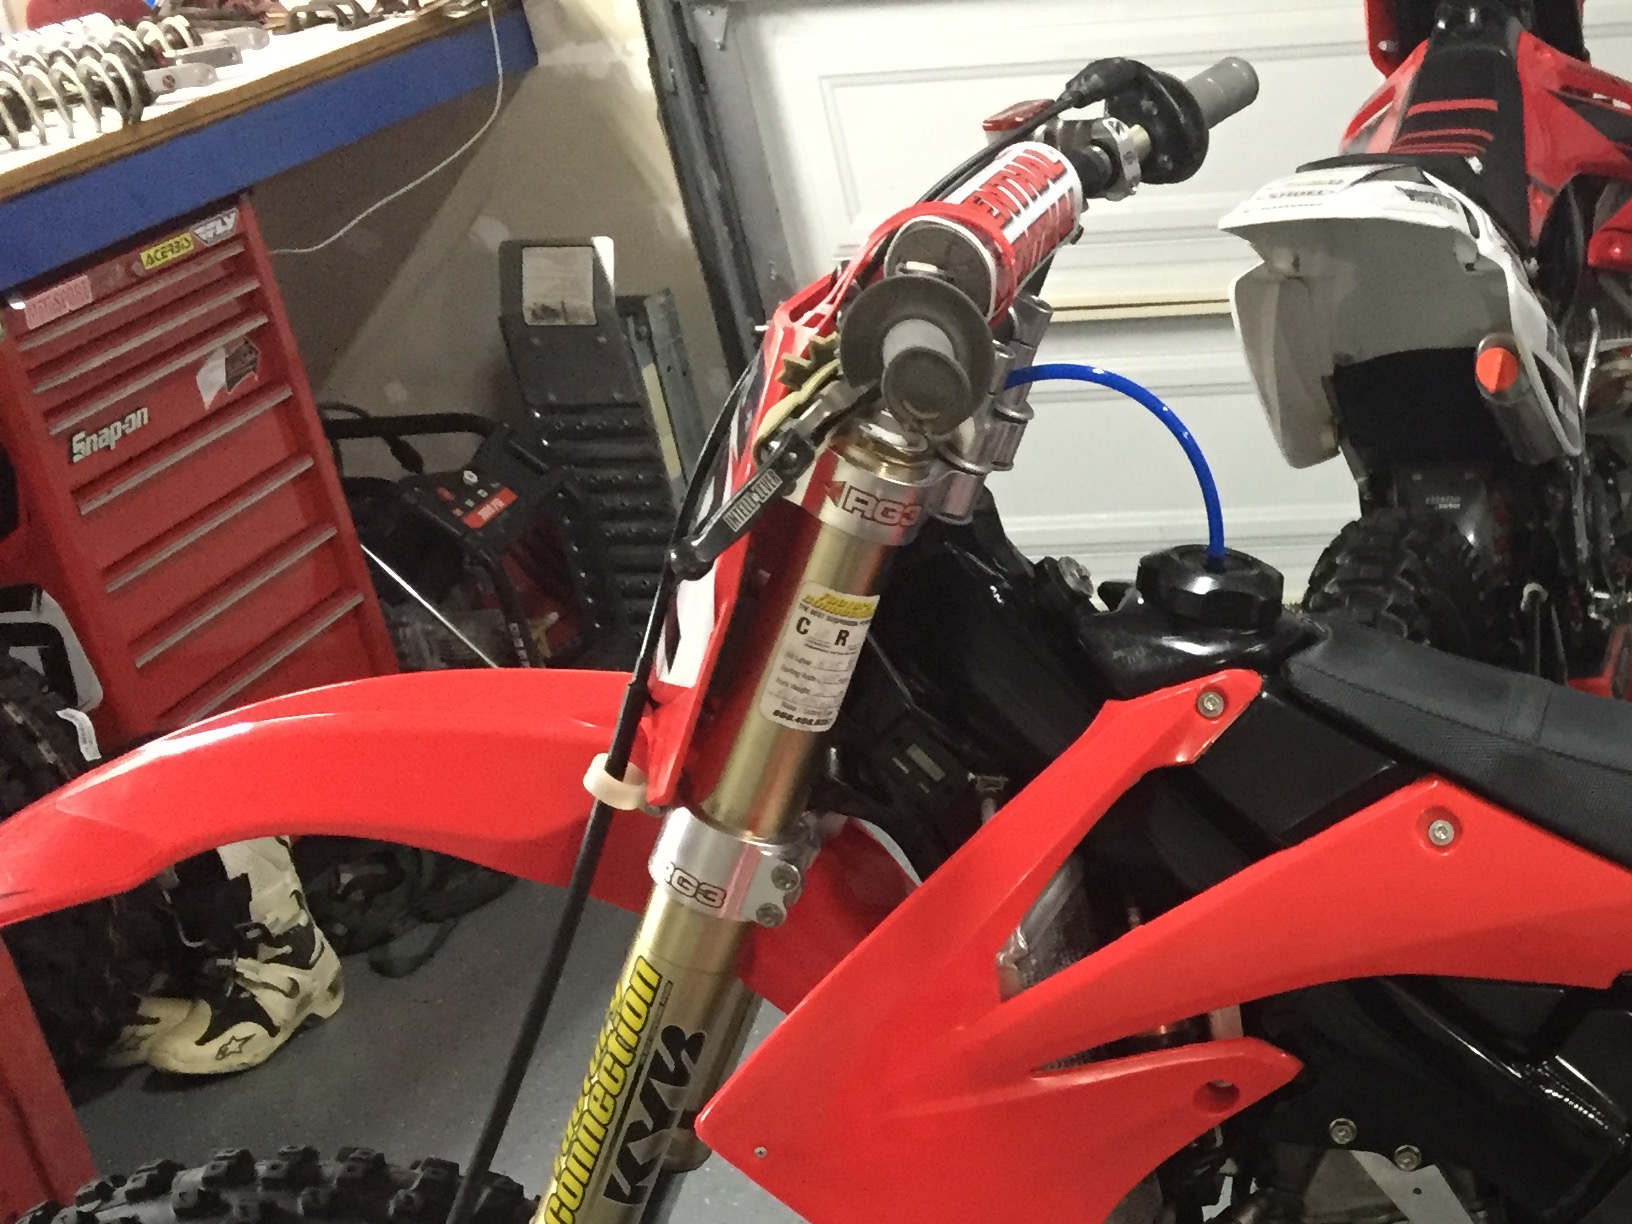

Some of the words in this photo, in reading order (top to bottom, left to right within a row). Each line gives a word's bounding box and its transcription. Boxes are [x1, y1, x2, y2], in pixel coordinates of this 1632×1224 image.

[72, 407, 149, 463] Snap-on
[796, 616, 811, 636] C
[834, 629, 850, 647] R
